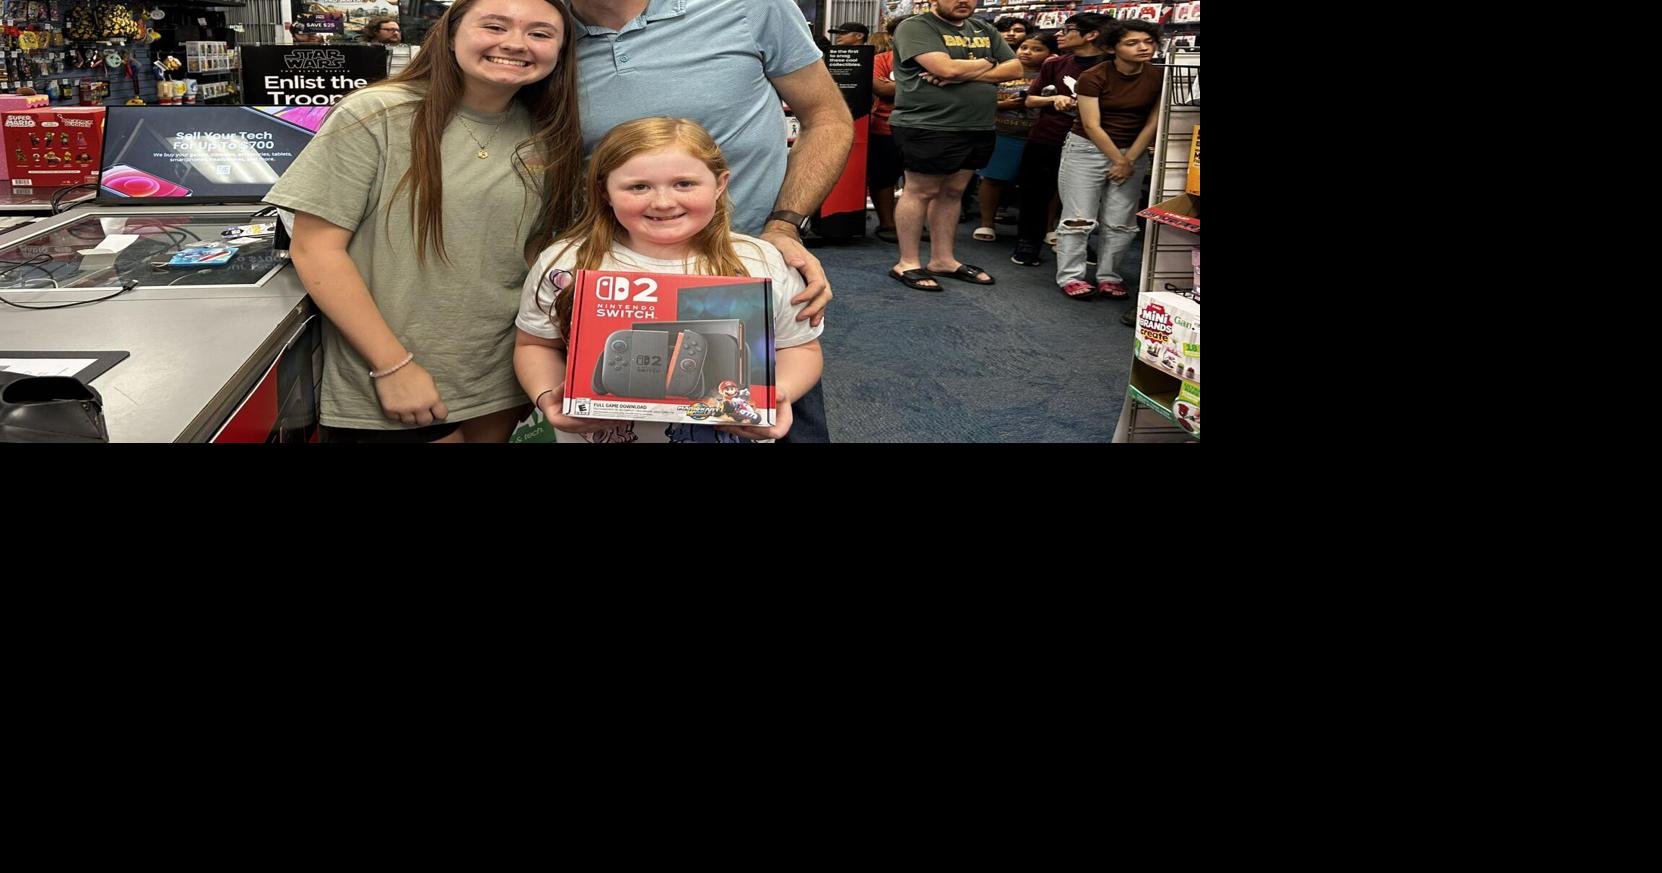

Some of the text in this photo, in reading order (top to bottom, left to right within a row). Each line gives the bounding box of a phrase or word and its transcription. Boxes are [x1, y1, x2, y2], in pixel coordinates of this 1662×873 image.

[284, 49, 345, 59] STAR
[284, 59, 345, 68] WARS
[264, 75, 368, 89] Enlist the
[5, 119, 36, 127] MARIO
[175, 131, 273, 140] Sell Your Tech
[173, 141, 274, 151] For Up To $700
[633, 277, 658, 302] 2
[597, 303, 655, 311] NINTENDO
[596, 308, 655, 319] SWITCH
[1139, 319, 1173, 334] BRANDS
[1141, 329, 1168, 342] create
[578, 403, 587, 412] E
